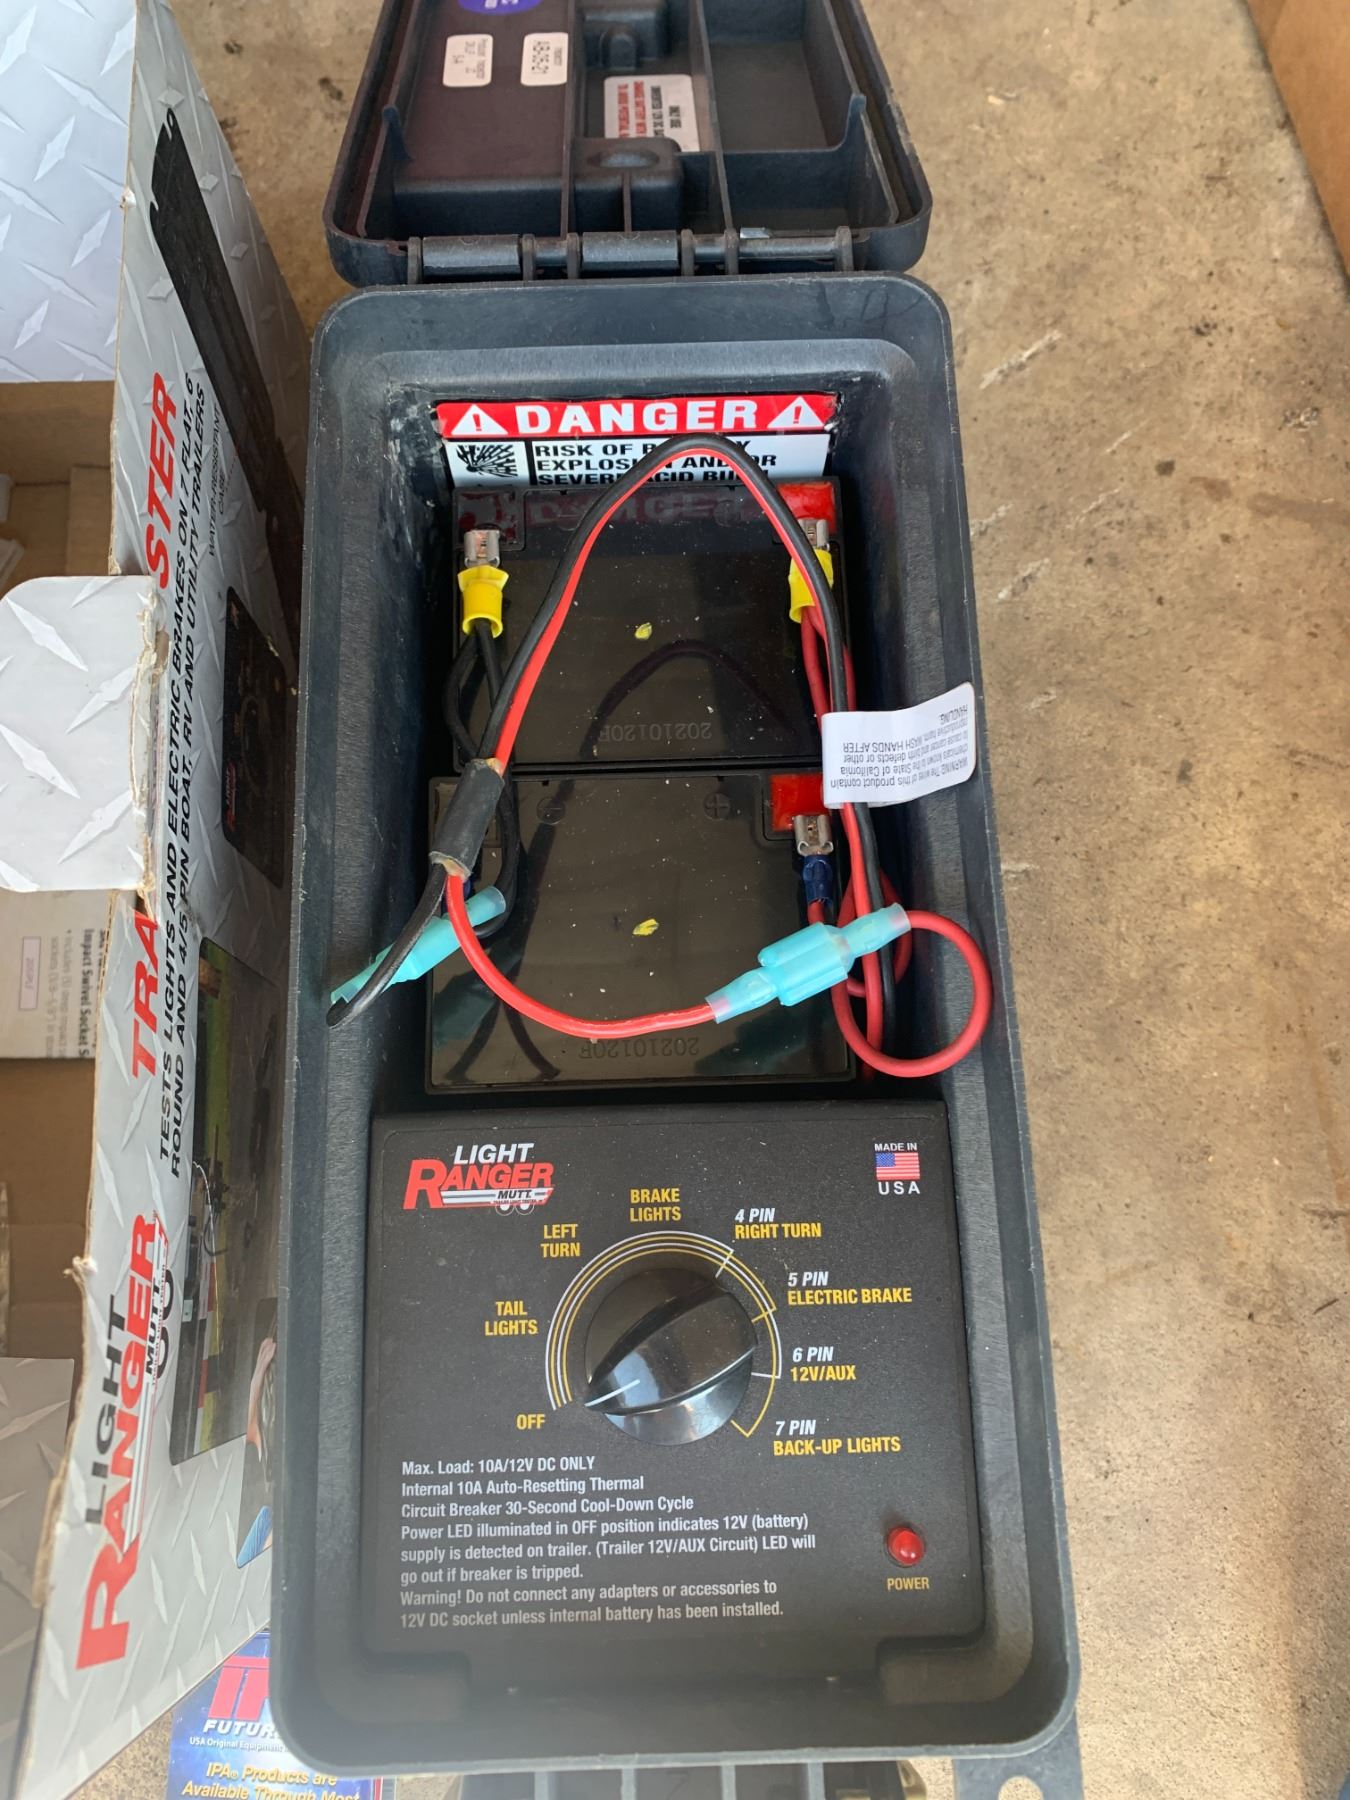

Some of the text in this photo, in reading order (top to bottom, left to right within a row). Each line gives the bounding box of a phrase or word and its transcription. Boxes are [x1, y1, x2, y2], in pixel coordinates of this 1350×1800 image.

[515, 400, 757, 434] DANGER
[534, 444, 593, 457] RISK
[602, 443, 633, 455] OF
[537, 473, 624, 485] SEVER
[598, 722, 712, 741] 20210120F
[843, 742, 870, 753] AFTER
[871, 741, 903, 752] HANDS
[160, 372, 194, 1160] TESTS LIGHTS AND ELECTRIC BRAKES ON 7 FLAT, 6
[843, 754, 864, 764] other
[867, 754, 875, 763] or
[877, 752, 906, 763] defects
[840, 766, 879, 777] California
[882, 766, 890, 776] of
[893, 763, 912, 775] State
[171, 381, 205, 1178] ROUND AND 4/5 PIN BOAT, RV AND UTILITY TRAILERS
[830, 778, 860, 789] contain
[863, 776, 895, 788] product
[80, 928, 94, 967] Impact
[80, 969, 94, 1006] Swivel
[79, 1008, 92, 1046] Socket
[579, 1037, 699, 1058] 20210120F
[454, 1143, 535, 1164] LIGHT
[874, 1142, 918, 1152] MADE IN
[403, 1158, 555, 1210] RANGER
[630, 1188, 681, 1203] BRAKE
[630, 1206, 682, 1222] LIGHTS
[735, 1207, 776, 1222] 4 PIN
[543, 1223, 578, 1239] LEFT
[735, 1222, 822, 1239] RIGHT TURN
[540, 1242, 581, 1258] TURN
[788, 1271, 829, 1286] 5 PIN
[788, 1287, 912, 1305] ELECTRIC BRAKE
[495, 1301, 528, 1316] TAIL
[146, 1277, 160, 1375] MUTT
[484, 1320, 538, 1336] LIGHTS
[792, 1346, 834, 1362] 6 PIN
[790, 1365, 856, 1382] 12V/AUX
[85, 1294, 125, 1524] LIGHT
[516, 1414, 546, 1430] OFF
[775, 1419, 816, 1436] 7 PIN
[75, 1214, 156, 1671] RANGER
[774, 1436, 901, 1456] BACK-UP LIGHTS
[402, 1456, 595, 1475] Max. Load: 10A/12V DC ONLY
[402, 1476, 644, 1496] Internal 10A Auto-Resetting Thermal
[401, 1496, 694, 1518] Circuit Breaker 30-Second Cool-Down Cycle
[401, 1513, 809, 1539] Power LED illuminated in OFF position indicates 12V (battery)
[401, 1534, 816, 1563] supply is detected on trailer. (Trailer 12V/AUX Circuit) LED will
[400, 1563, 583, 1587] go out if breaker is tripped.
[887, 1577, 930, 1591] POWER
[400, 1580, 777, 1607] Warning! Do not connect any adapters or accessories to
[400, 1601, 784, 1628] 12V DC socket unless internal battery has been installed.
[203, 1719, 280, 1739] FUTUR
[189, 1736, 206, 1746] USA
[207, 1738, 238, 1749] Original
[242, 1764, 309, 1784] Products
[312, 1773, 337, 1786] are
[182, 1780, 249, 1800] Available
[254, 1784, 317, 1800] Through
